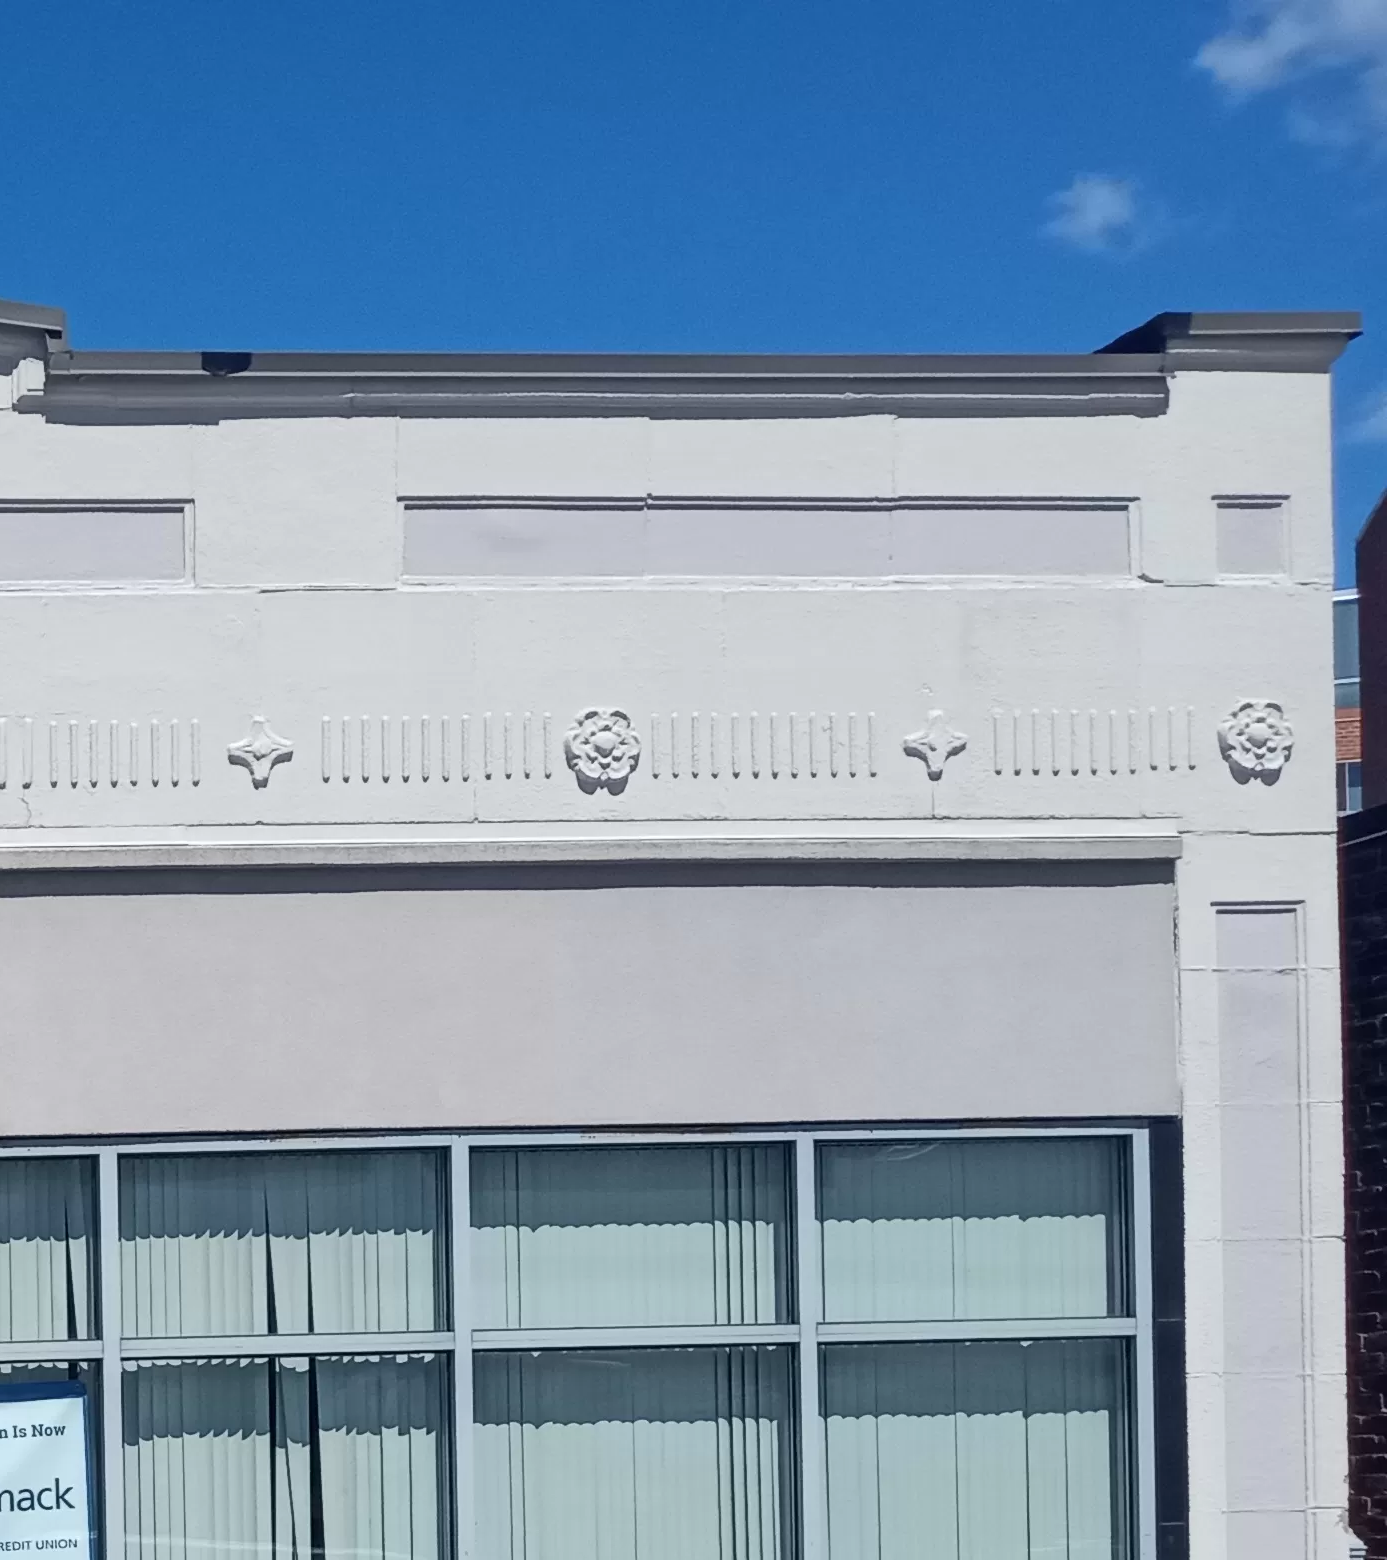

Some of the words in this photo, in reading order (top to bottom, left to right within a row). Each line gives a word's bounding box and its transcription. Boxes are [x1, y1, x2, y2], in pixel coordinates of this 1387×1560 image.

[12, 1425, 27, 1439] Is
[31, 1424, 66, 1438] Now
[36, 1538, 78, 1550] UNION
